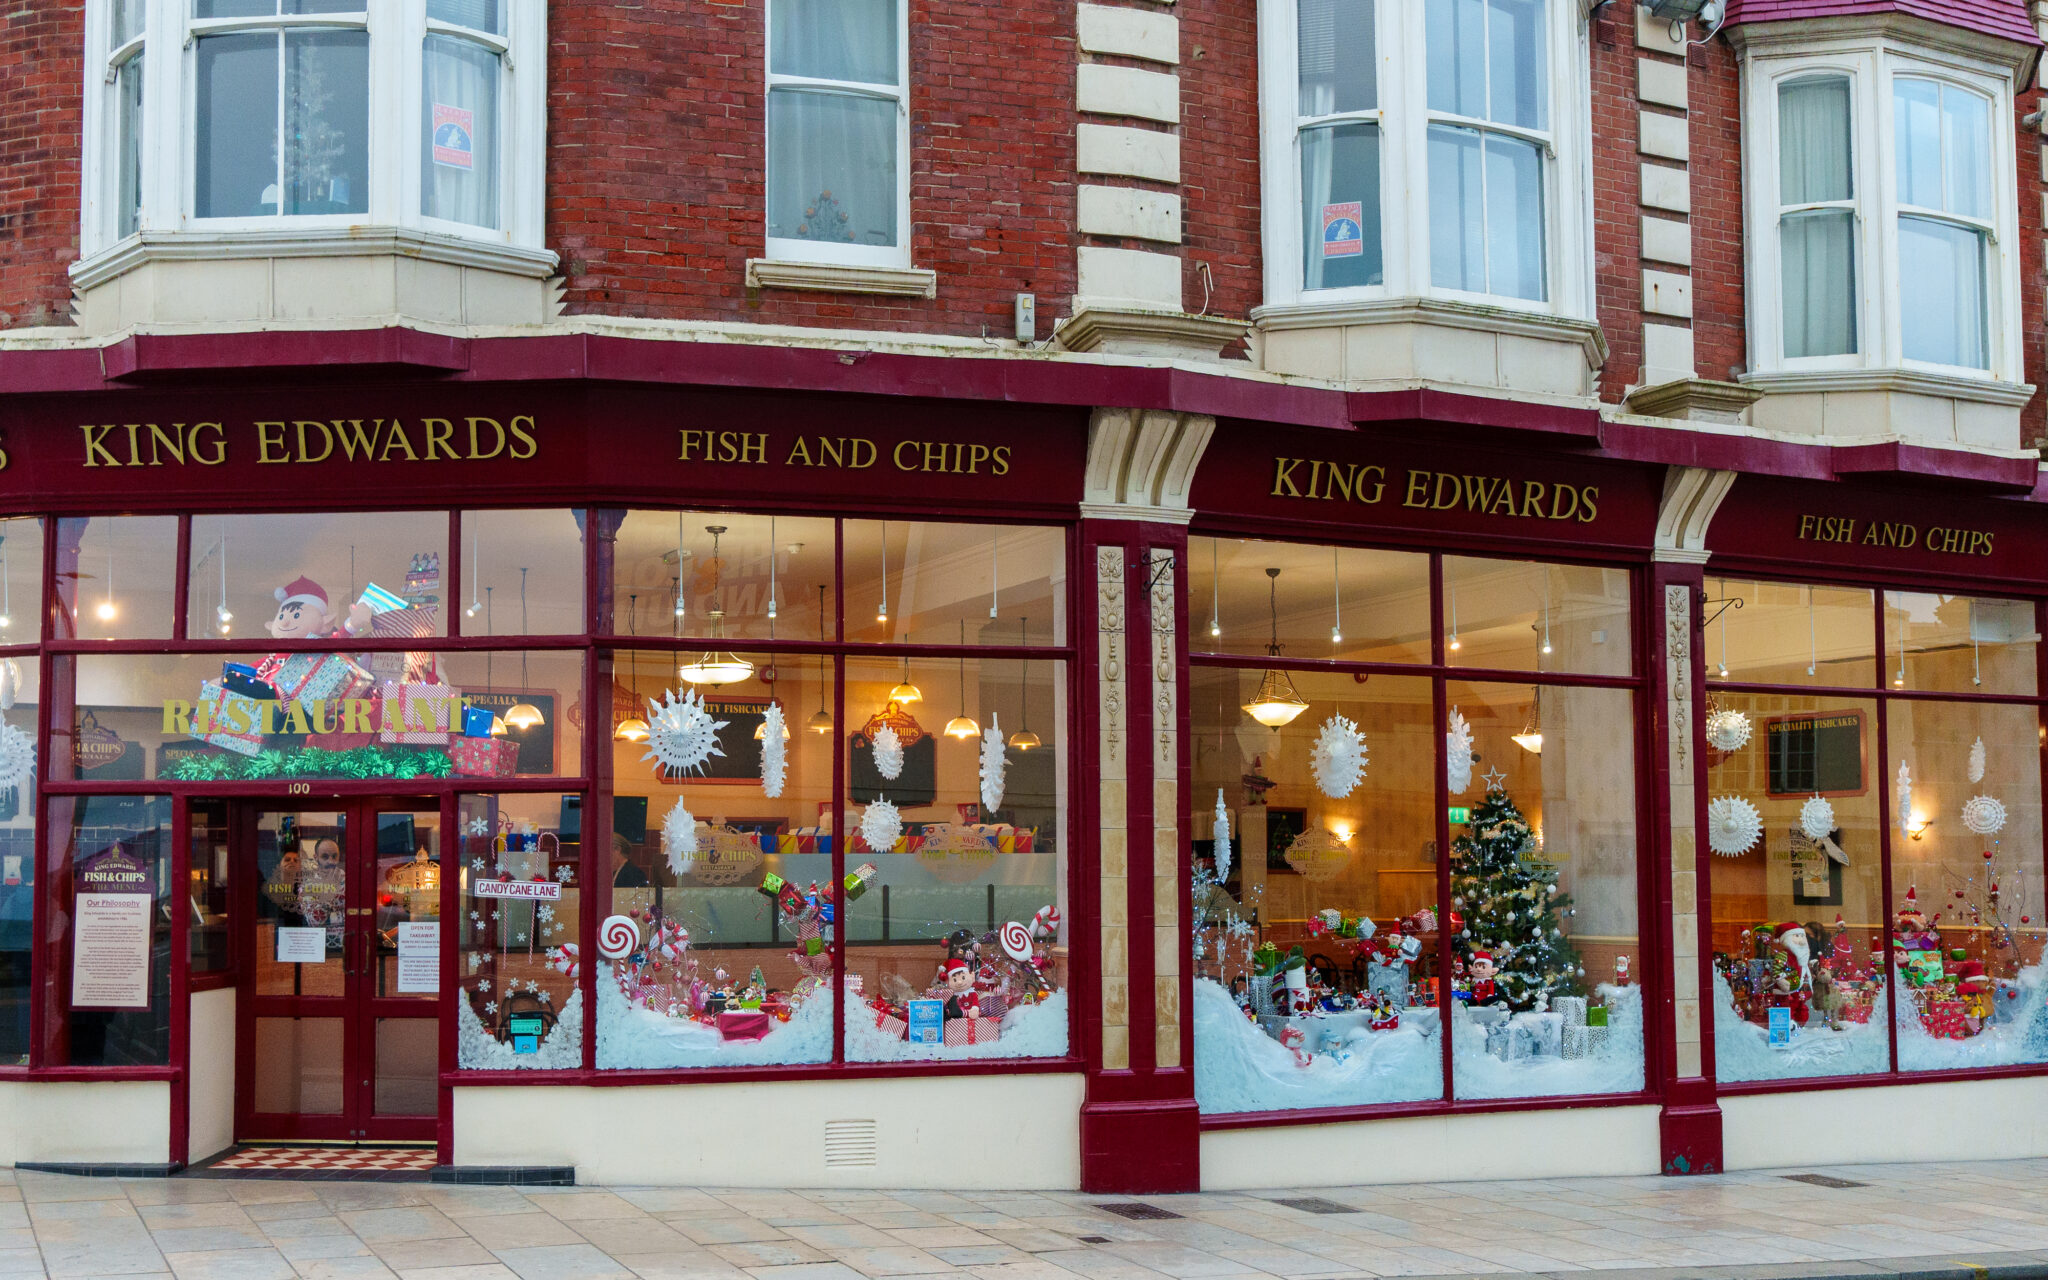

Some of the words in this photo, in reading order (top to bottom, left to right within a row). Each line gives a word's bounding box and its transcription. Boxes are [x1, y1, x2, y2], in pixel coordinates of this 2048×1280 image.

[81, 422, 228, 468] KING
[255, 415, 538, 464] EDWARDS
[678, 429, 769, 464] FISH
[785, 436, 878, 468] AND
[892, 440, 1012, 476] CHIPS
[1271, 456, 1387, 504] KING
[1403, 469, 1600, 524] EDWARDS
[1798, 514, 1856, 544] FISH
[1862, 522, 1917, 549] AND
[1925, 527, 1995, 557] CHIPS
[467, 694, 519, 706] SPECIALS
[161, 697, 472, 735] RESTAURANT
[1769, 721, 1812, 733] SPECIALITY
[1815, 717, 1858, 729] FISHCAKES
[894, 727, 919, 738] CHIPS
[288, 783, 310, 795] 100
[680, 850, 708, 861] FISH
[721, 850, 757, 862] CHIPS
[94, 863, 109, 871] KING
[109, 863, 137, 871] EDWARDS
[92, 883, 110, 891] THE
[111, 883, 137, 891] MENU
[268, 883, 292, 894] FISH
[479, 882, 509, 894] CANDY
[509, 884, 532, 895] CANE
[534, 885, 557, 897] LANE
[87, 899, 100, 908] Our
[101, 899, 140, 909] Philosophy
